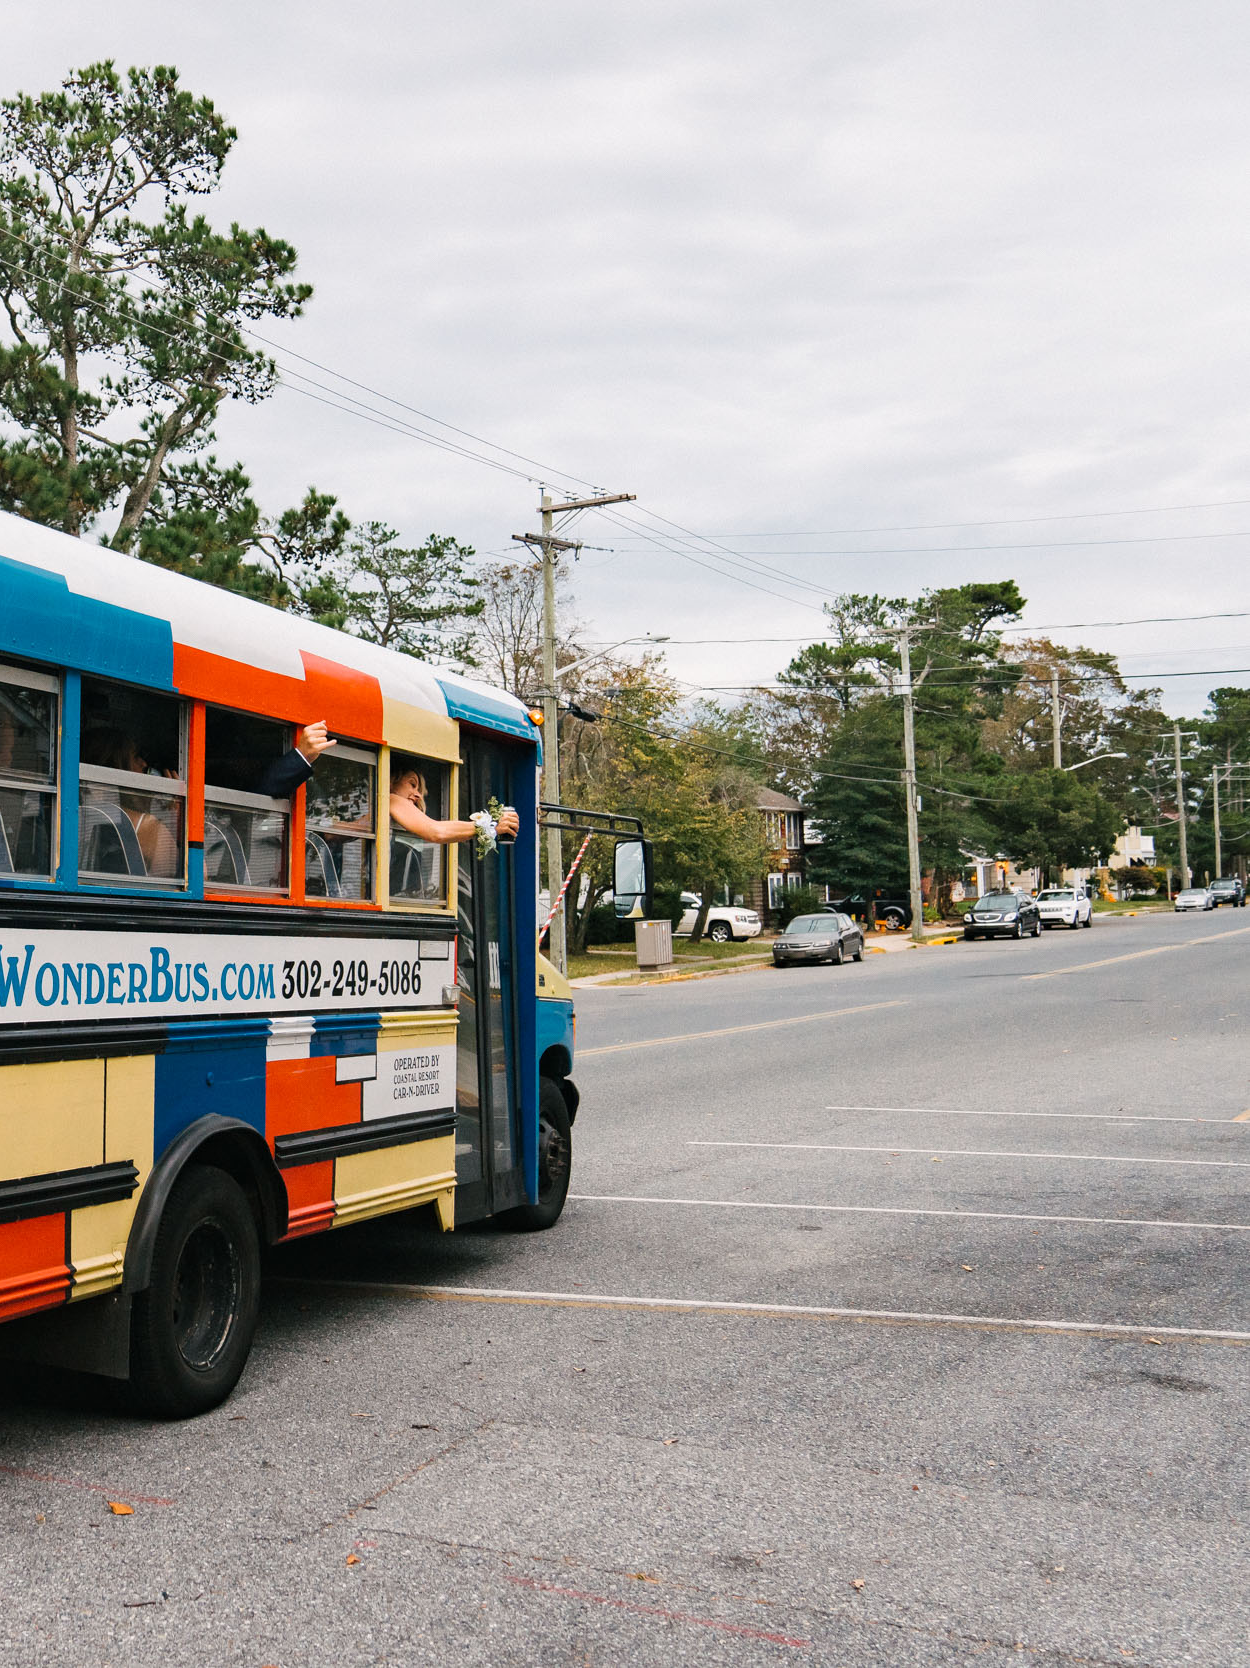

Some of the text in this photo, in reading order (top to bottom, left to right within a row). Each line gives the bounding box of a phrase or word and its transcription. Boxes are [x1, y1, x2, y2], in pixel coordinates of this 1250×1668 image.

[281, 959, 422, 1000] 302-249-5086
[393, 1054, 440, 1071] OPERATED BY
[393, 1070, 440, 1085] COASTAL RESORT
